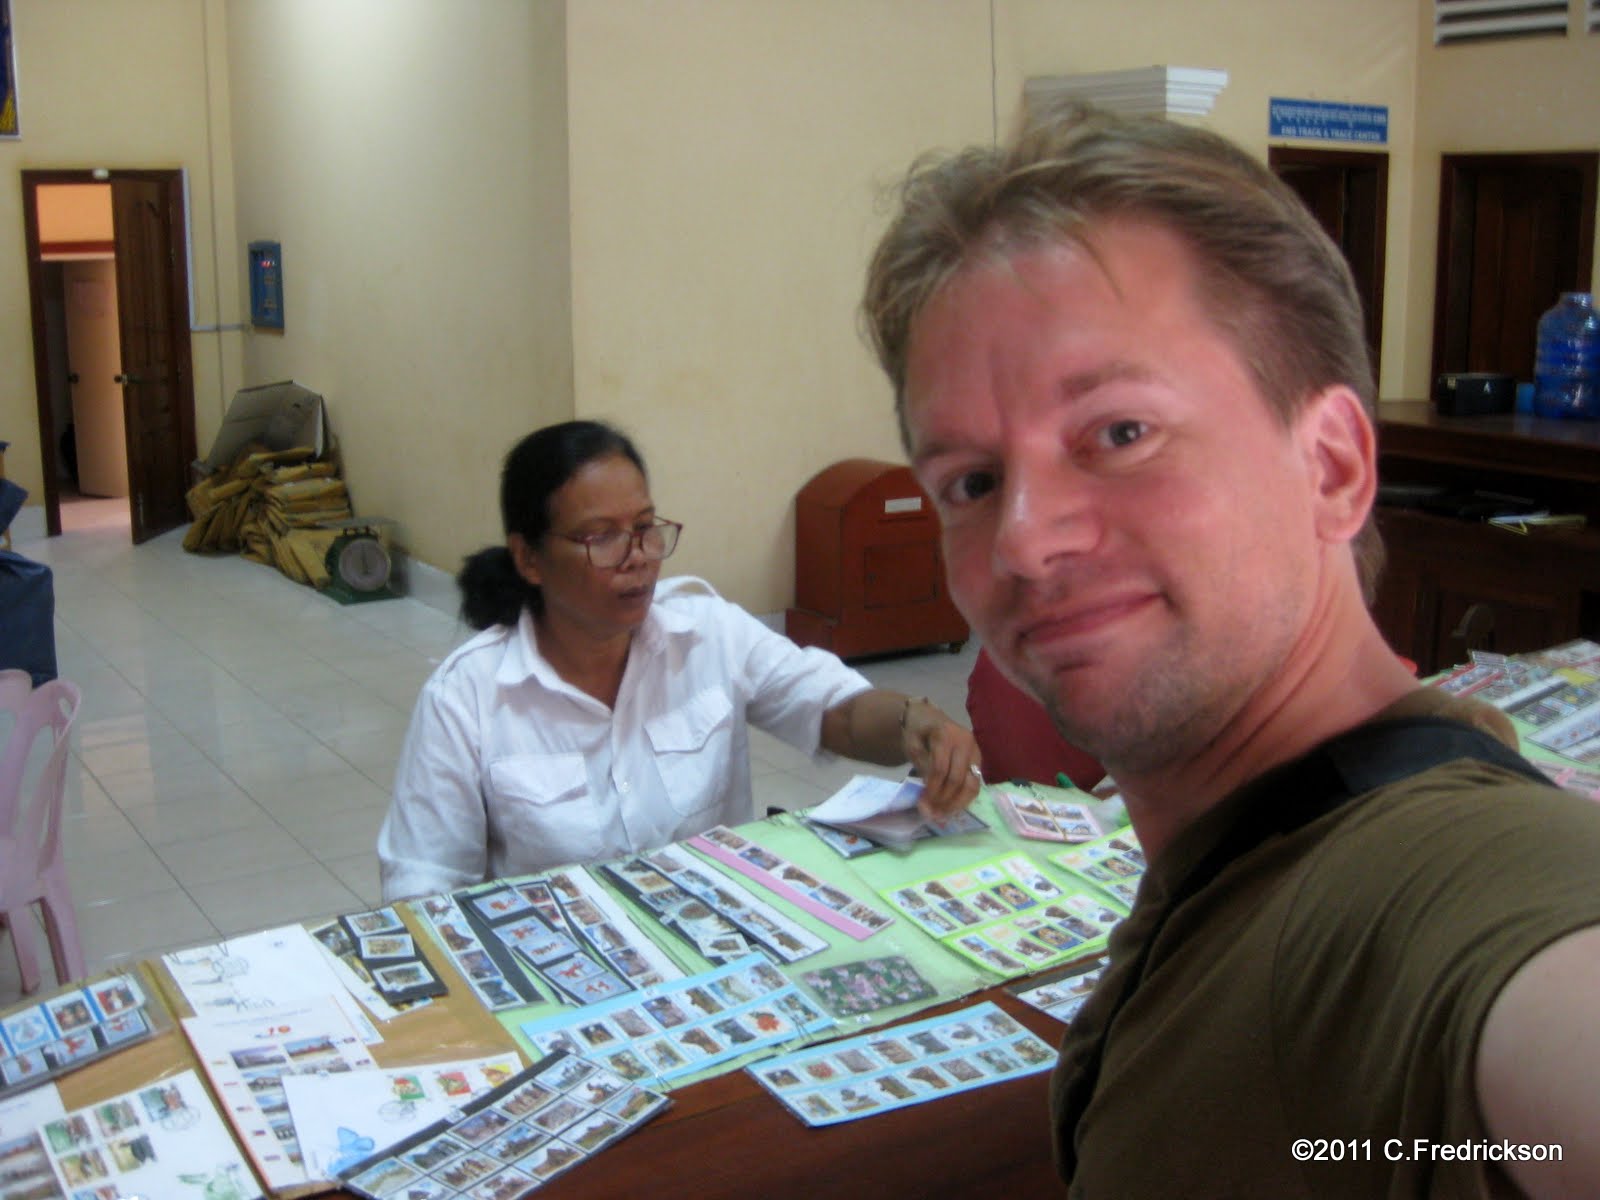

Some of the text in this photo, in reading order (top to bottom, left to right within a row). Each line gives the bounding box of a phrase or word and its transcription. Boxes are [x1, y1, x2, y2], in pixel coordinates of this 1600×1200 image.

[1281, 125, 1296, 136] EMS
[1298, 126, 1322, 137] TRACK
[1331, 128, 1353, 139] TRACE
[1354, 129, 1381, 141] CENTER
